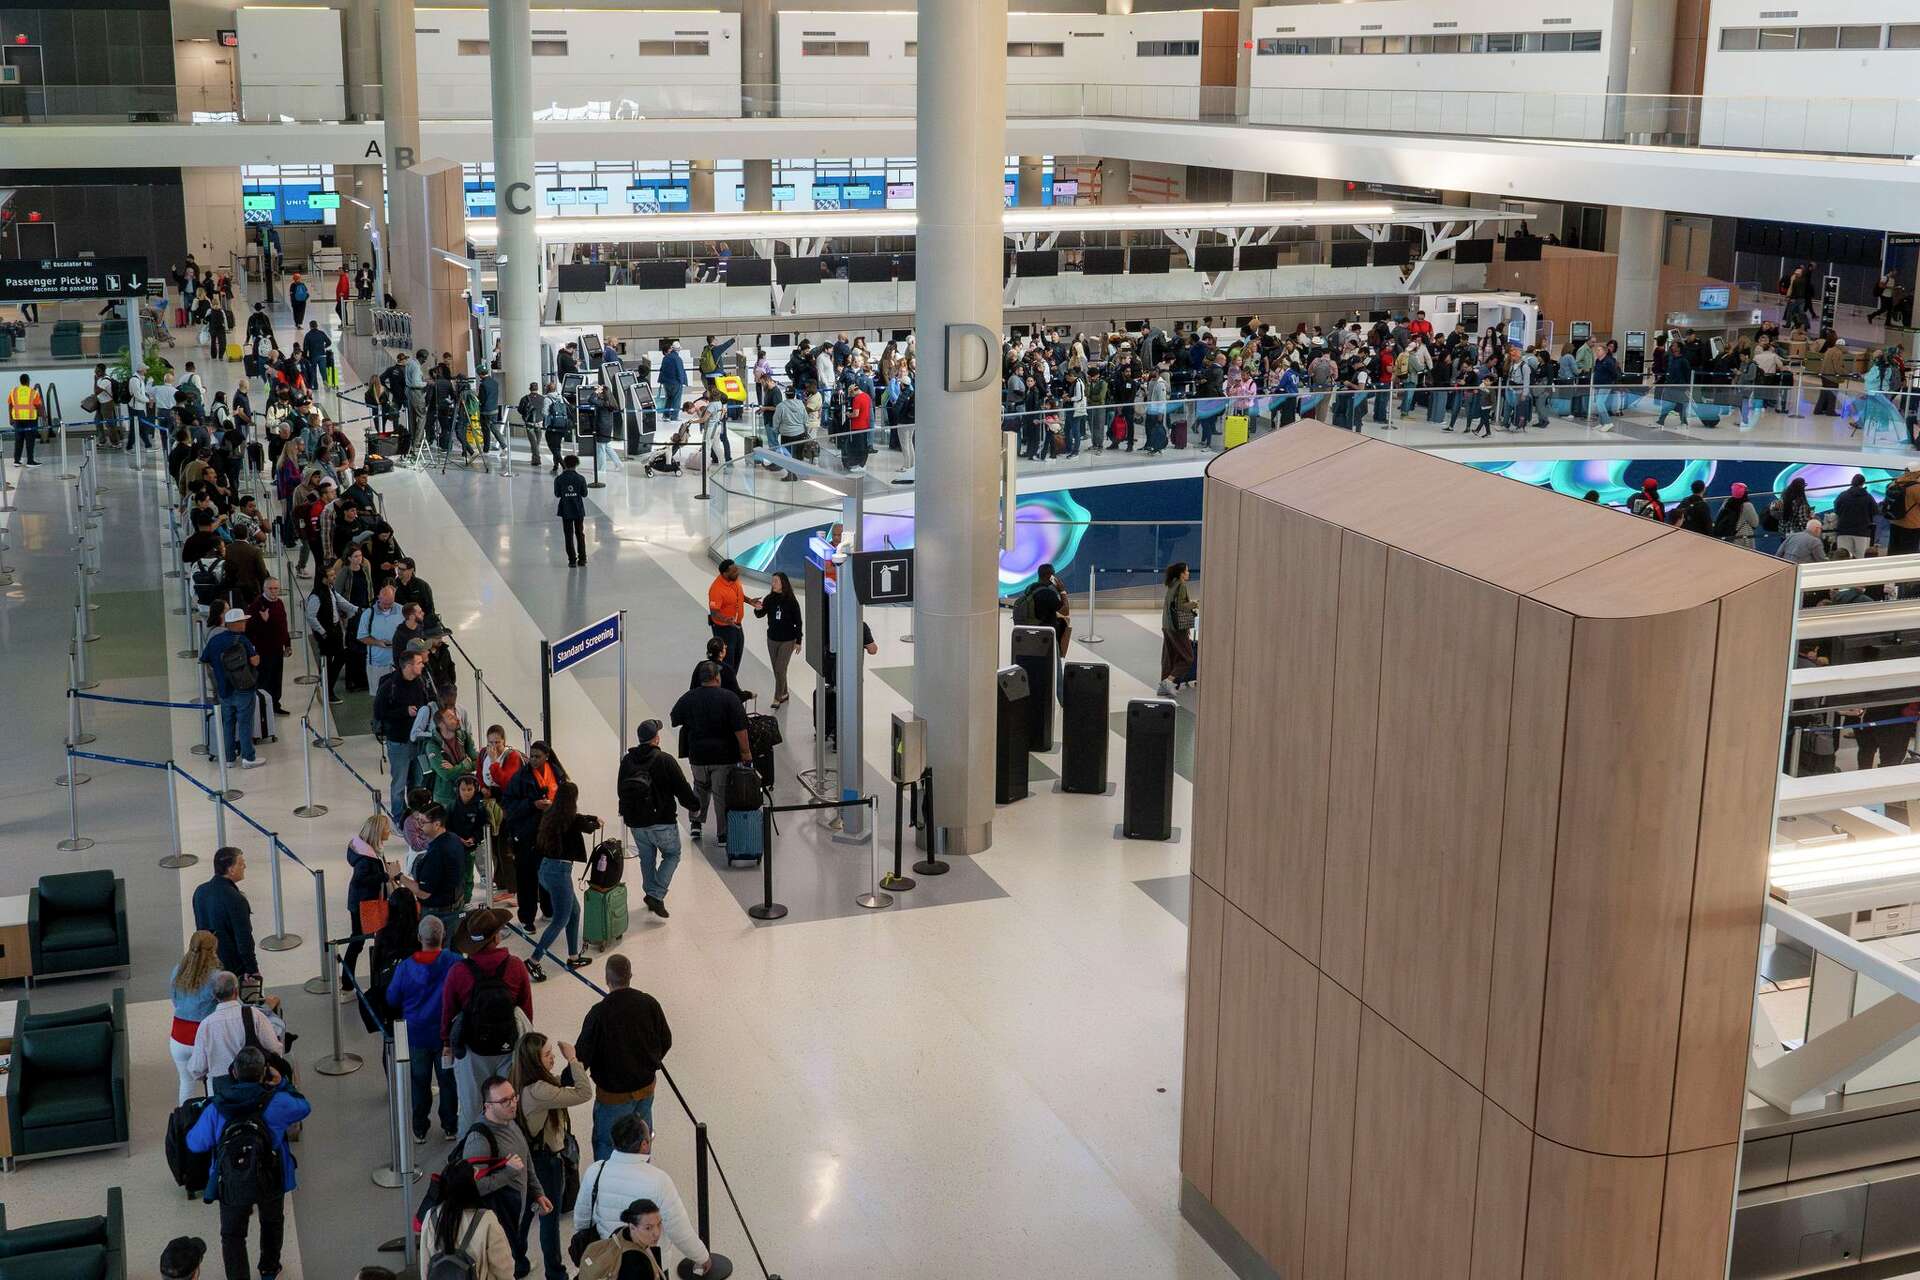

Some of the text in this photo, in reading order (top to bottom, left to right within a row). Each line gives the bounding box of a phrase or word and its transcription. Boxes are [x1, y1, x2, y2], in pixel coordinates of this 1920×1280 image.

[365, 140, 382, 158] A
[395, 147, 415, 170] B
[505, 182, 532, 215] C
[6, 276, 98, 287] Passenger Pick-Up
[944, 323, 1000, 393] D
[557, 627, 614, 663] Standard Screening
